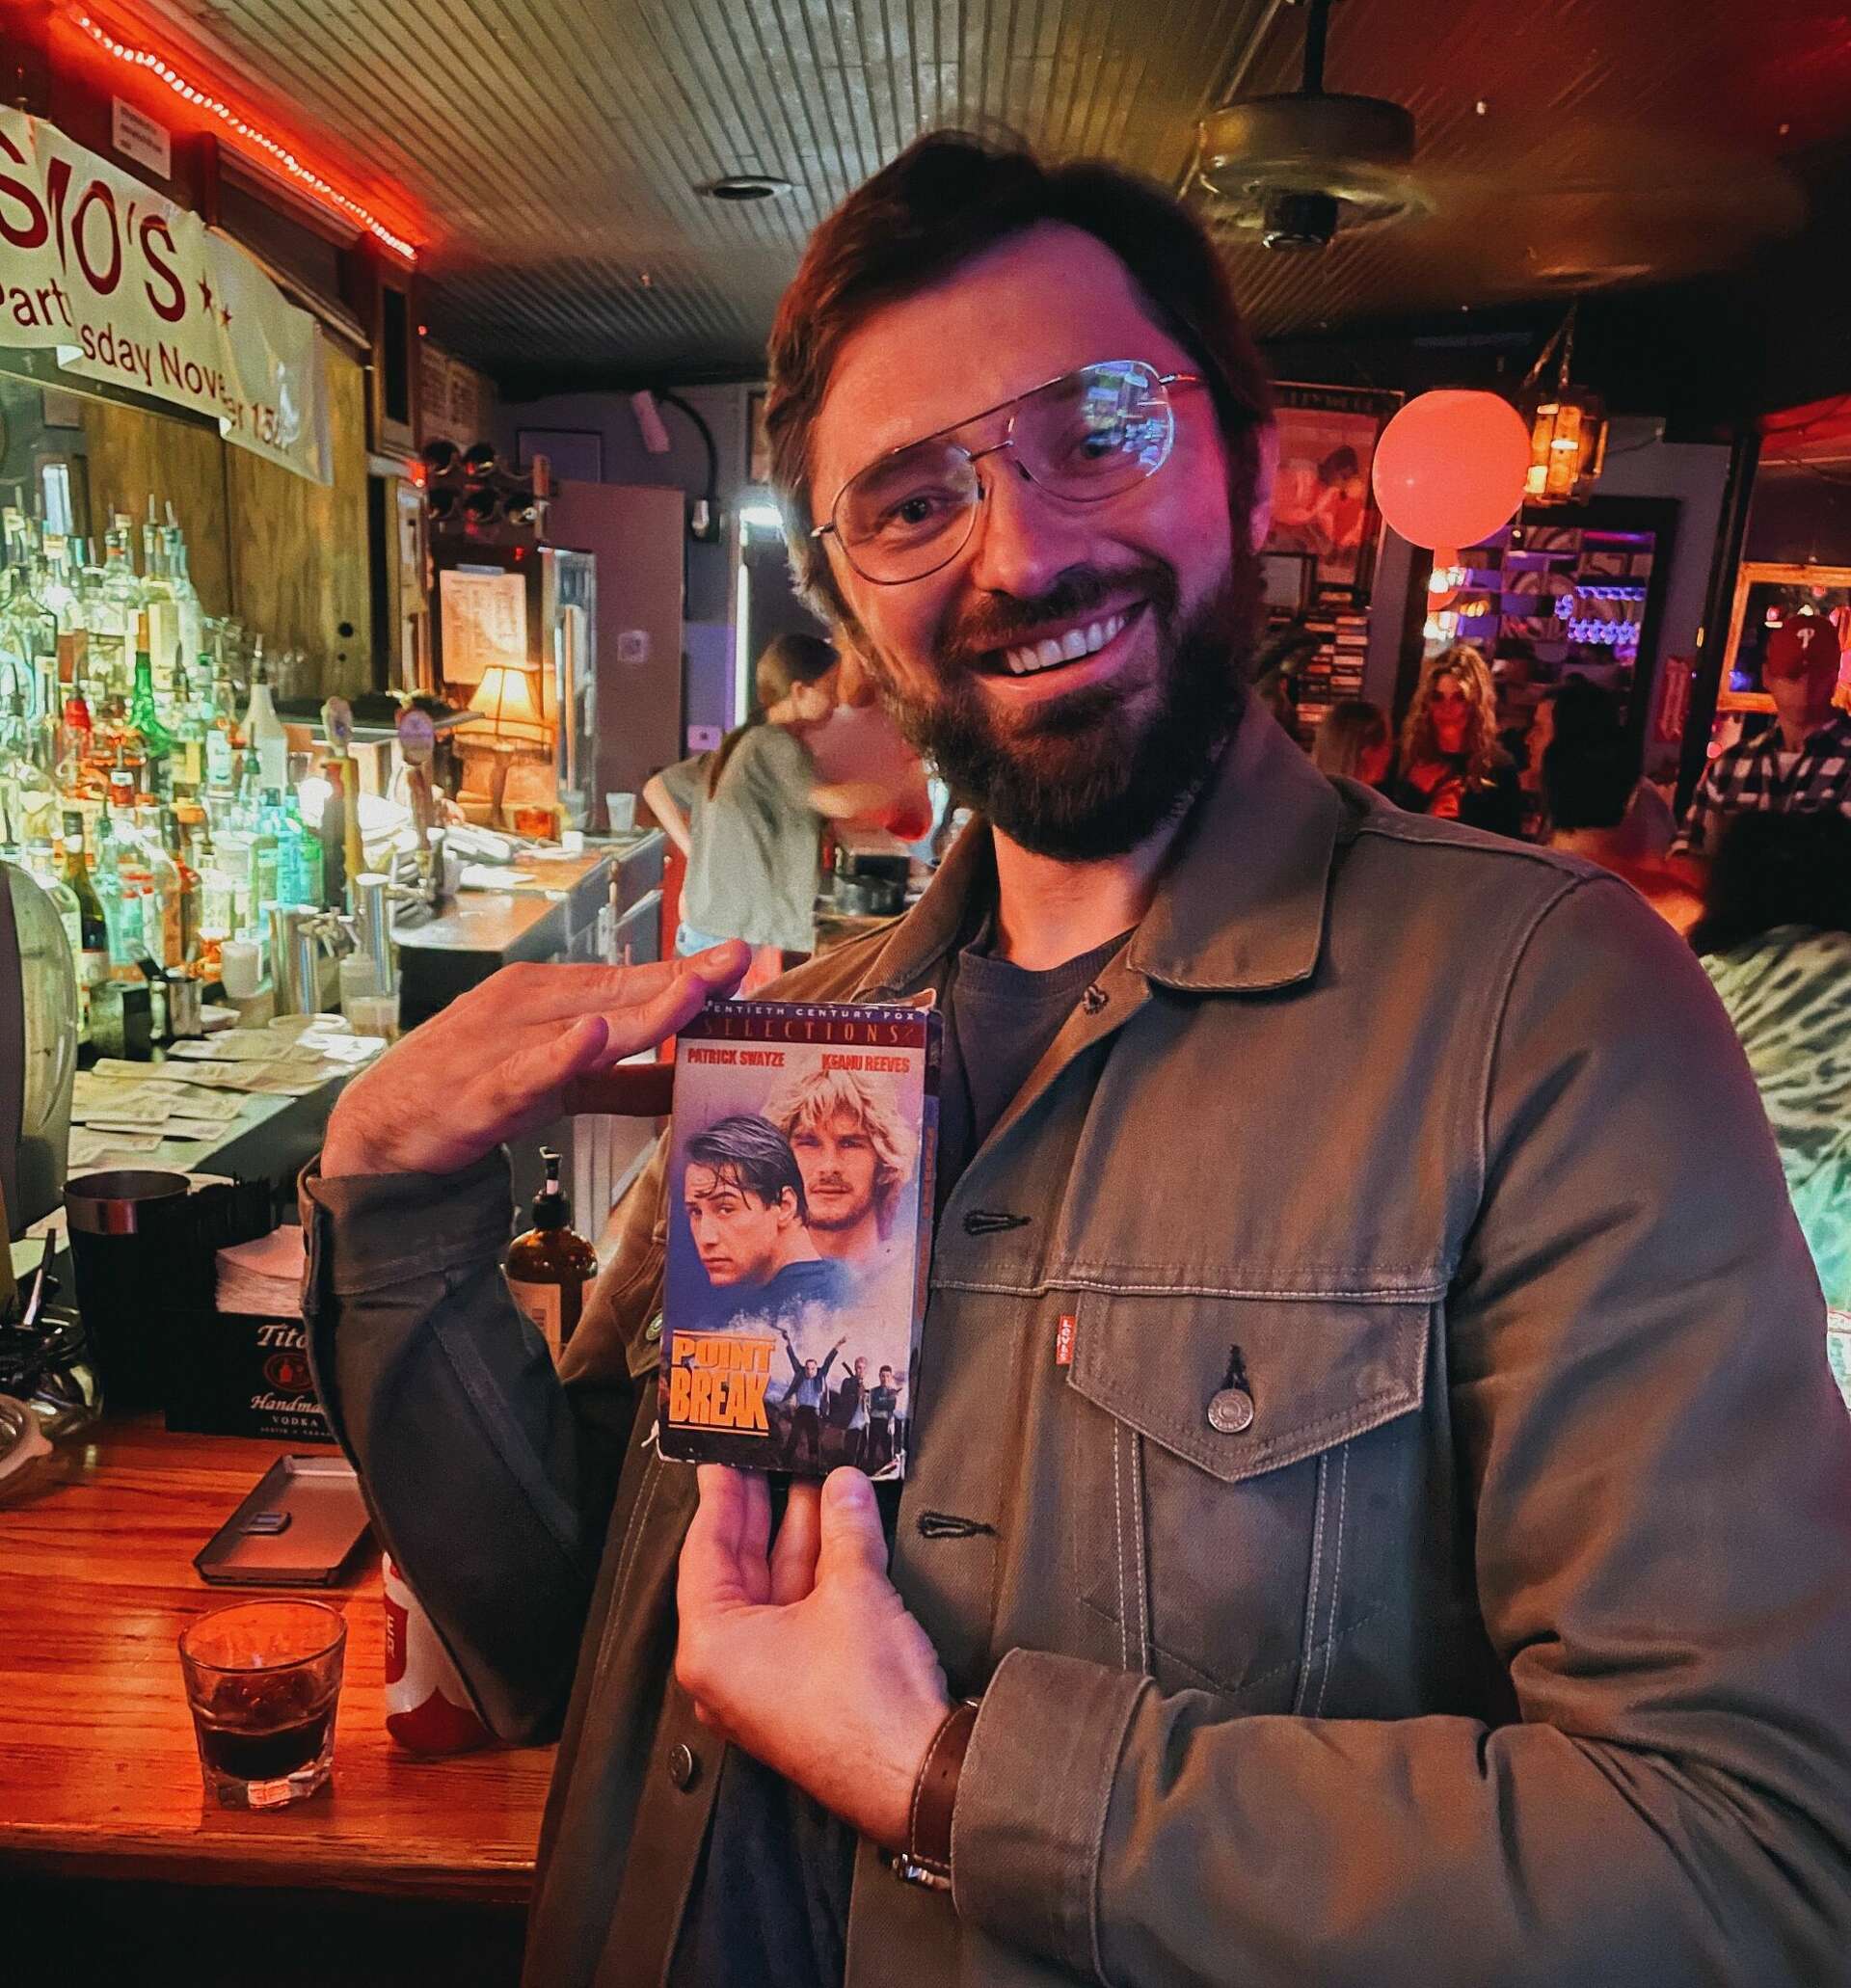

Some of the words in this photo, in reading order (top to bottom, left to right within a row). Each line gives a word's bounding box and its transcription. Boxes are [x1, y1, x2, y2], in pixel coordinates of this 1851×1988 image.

[794, 1007, 872, 1020] CENTURY
[883, 1011, 915, 1022] FOX
[704, 1018, 899, 1044] SELECTIONS
[686, 1047, 738, 1065] PATRICK
[739, 1051, 786, 1067] SWAYZE
[821, 1054, 863, 1071] KEANU
[865, 1056, 911, 1073] REEVES
[672, 1336, 775, 1373] POINT
[668, 1366, 771, 1431] BREAK
[272, 1415, 319, 1427] VODKA
